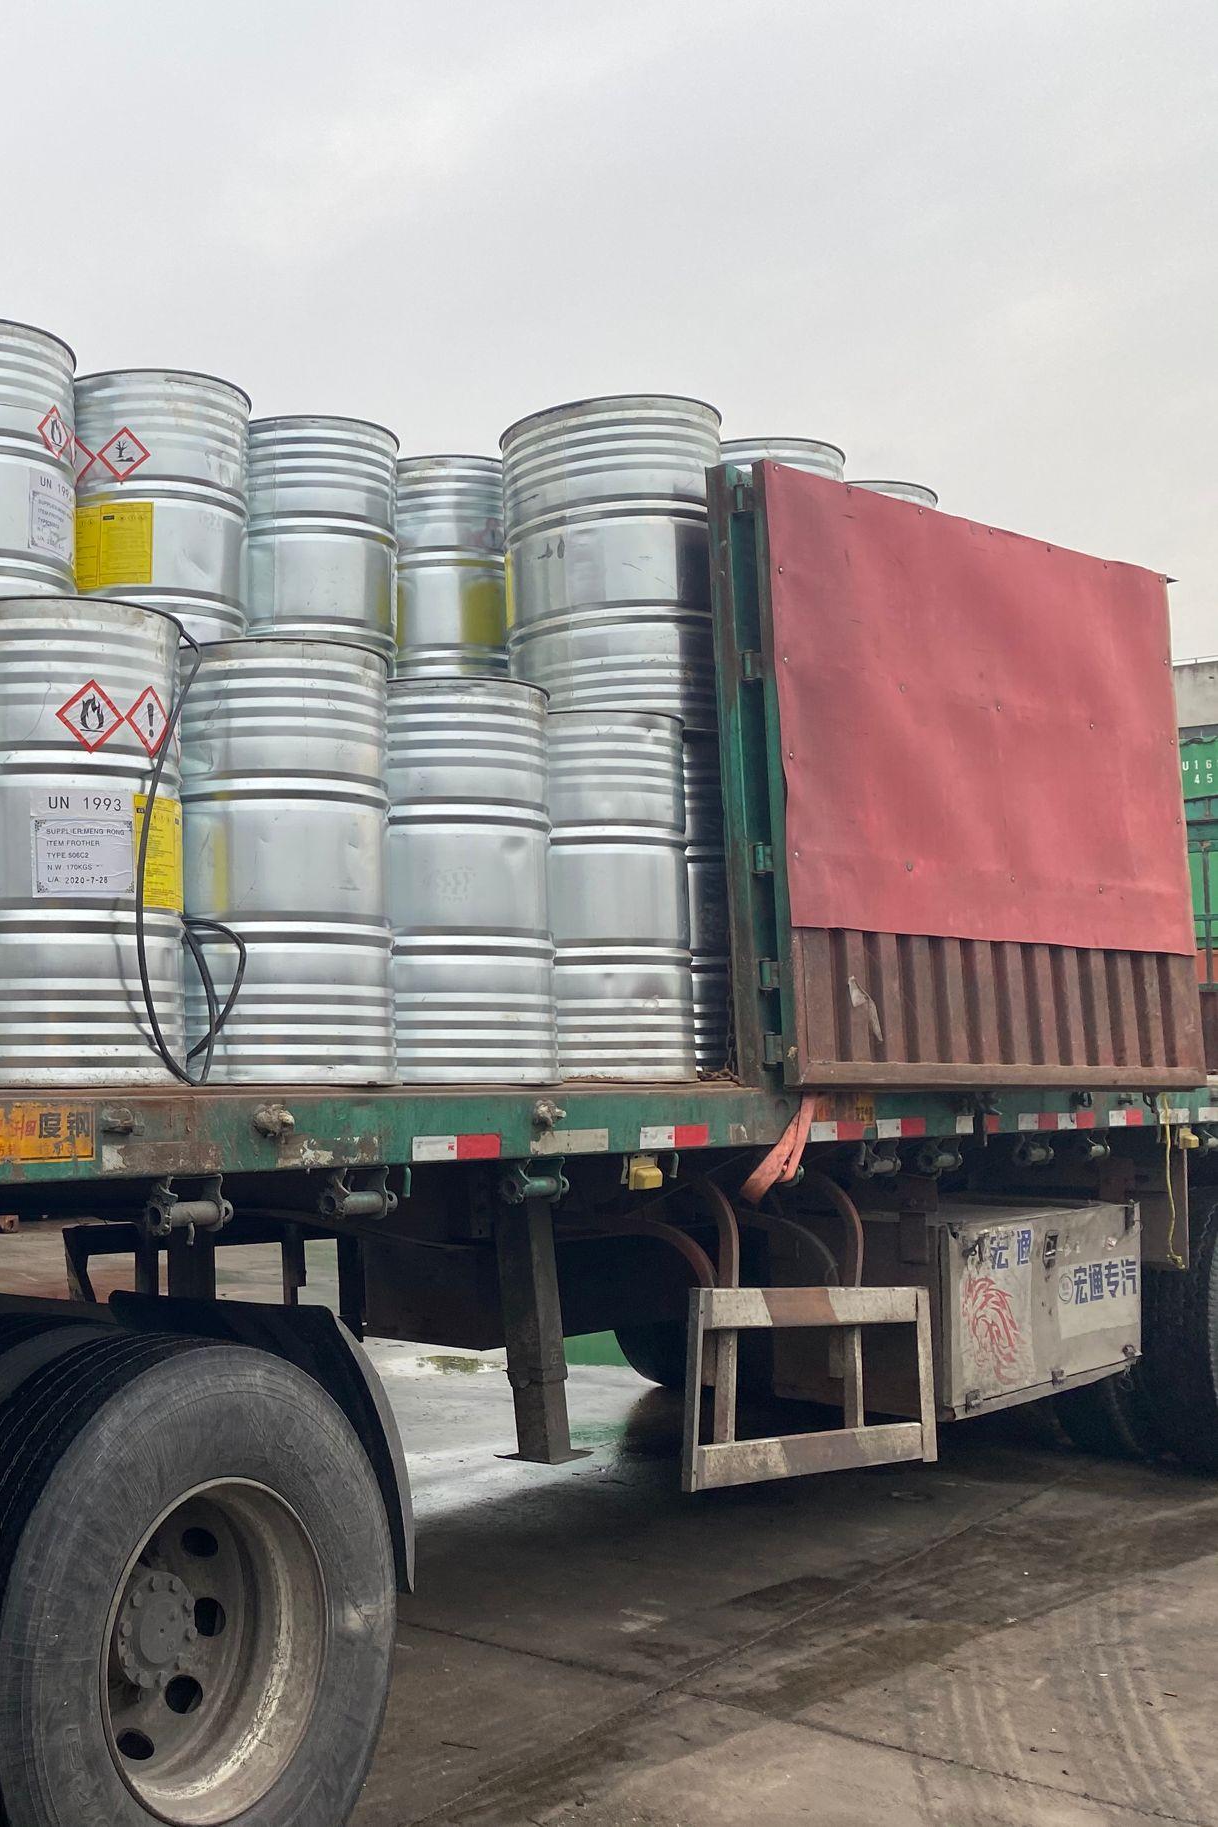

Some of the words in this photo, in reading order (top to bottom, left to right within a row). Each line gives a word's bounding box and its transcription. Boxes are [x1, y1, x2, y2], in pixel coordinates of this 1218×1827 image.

[40, 475, 52, 489] UN
[48, 796, 70, 810] UN
[83, 796, 122, 812] 1993
[46, 828, 104, 836] SUPPLER:MENG
[106, 828, 125, 836] RONG
[65, 876, 108, 885] 2020-7-28
[1073, 1257, 1137, 1305] 宏通专汽
